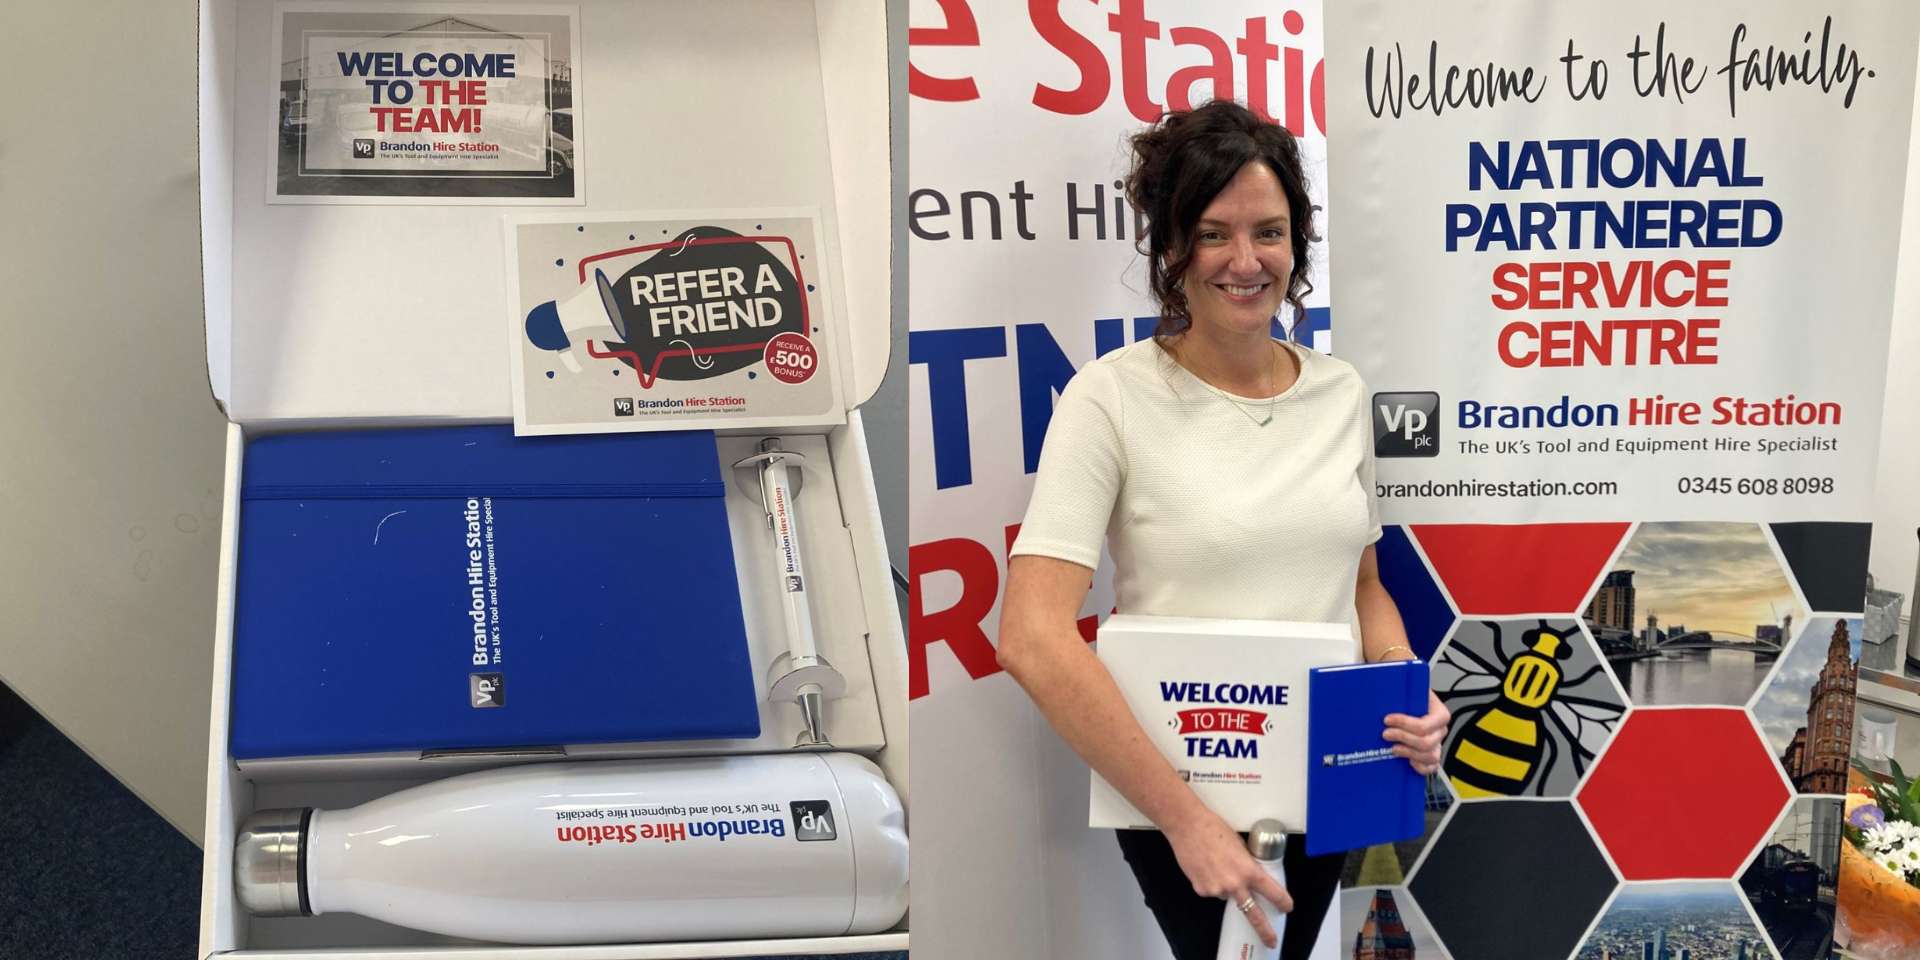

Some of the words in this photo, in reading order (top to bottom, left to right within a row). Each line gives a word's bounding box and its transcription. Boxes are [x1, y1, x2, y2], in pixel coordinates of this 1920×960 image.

[337, 51, 516, 78] WELCOME
[1028, 0, 1327, 138] Stati
[1365, 40, 1547, 119] Welcome
[1560, 38, 1609, 102] to
[1626, 21, 1707, 105] the
[1717, 16, 1876, 118] family.
[365, 79, 414, 105] TO
[419, 80, 488, 106] THE
[369, 107, 482, 134] TEAM!
[380, 141, 431, 151] Brandon
[433, 141, 456, 151] Hire
[459, 142, 499, 152] Station
[1468, 138, 1764, 191] NATIONAL
[1445, 199, 1783, 252] PARTNERED
[629, 267, 748, 306] REFER
[755, 263, 783, 294] A
[1491, 259, 1731, 311] SERVICE
[650, 297, 783, 338] FRIEND
[776, 341, 804, 352] RECEIVE
[1497, 318, 1721, 369] CENTRE
[770, 350, 813, 370] £500
[638, 398, 684, 408] Brandon
[685, 397, 707, 407] Hire
[708, 396, 746, 406] Station
[1458, 395, 1618, 429] Brandon
[1628, 394, 1701, 426] Hire
[1711, 394, 1842, 426] Station
[1379, 404, 1427, 440] Vp
[1414, 434, 1432, 449] plc
[1458, 440, 1489, 454] The
[1496, 440, 1531, 454] UK's
[1536, 439, 1571, 453] Tool
[1577, 438, 1609, 452] and
[1616, 438, 1708, 455] Equipment
[1715, 437, 1751, 452] Hire
[1757, 436, 1838, 455] Specialist
[1376, 478, 1617, 498] brandonhirestation.com
[1678, 477, 1732, 494] 0345
[1737, 478, 1779, 496] 608
[1783, 477, 1834, 495] 8098
[482, 497, 494, 524] Special
[774, 487, 786, 518] Station
[463, 497, 482, 548] Statio
[779, 517, 789, 536] Hire
[485, 526, 494, 542] Hire
[486, 543, 497, 587] Equipment
[782, 535, 795, 573] Brandon
[466, 549, 484, 585] Hire
[488, 589, 498, 605] and
[468, 587, 489, 665] Brandon
[490, 607, 499, 625] Tool
[491, 626, 500, 646] UK's
[493, 648, 501, 664] The
[476, 679, 496, 705] Vp
[1160, 682, 1289, 705] WELCOME
[1190, 713, 1215, 730] TO
[1217, 712, 1251, 730] THE
[1184, 737, 1258, 759] TEAM
[556, 808, 604, 821] Specialist
[607, 809, 628, 819] Hire
[630, 805, 686, 817] Equipment
[689, 806, 708, 816] and
[711, 804, 732, 815] Tool
[736, 803, 758, 814] UK's
[761, 803, 781, 812] The
[640, 823, 686, 843] Hire
[688, 818, 785, 841] Brandon
[800, 811, 832, 834] Vp
[557, 824, 637, 846] Station
